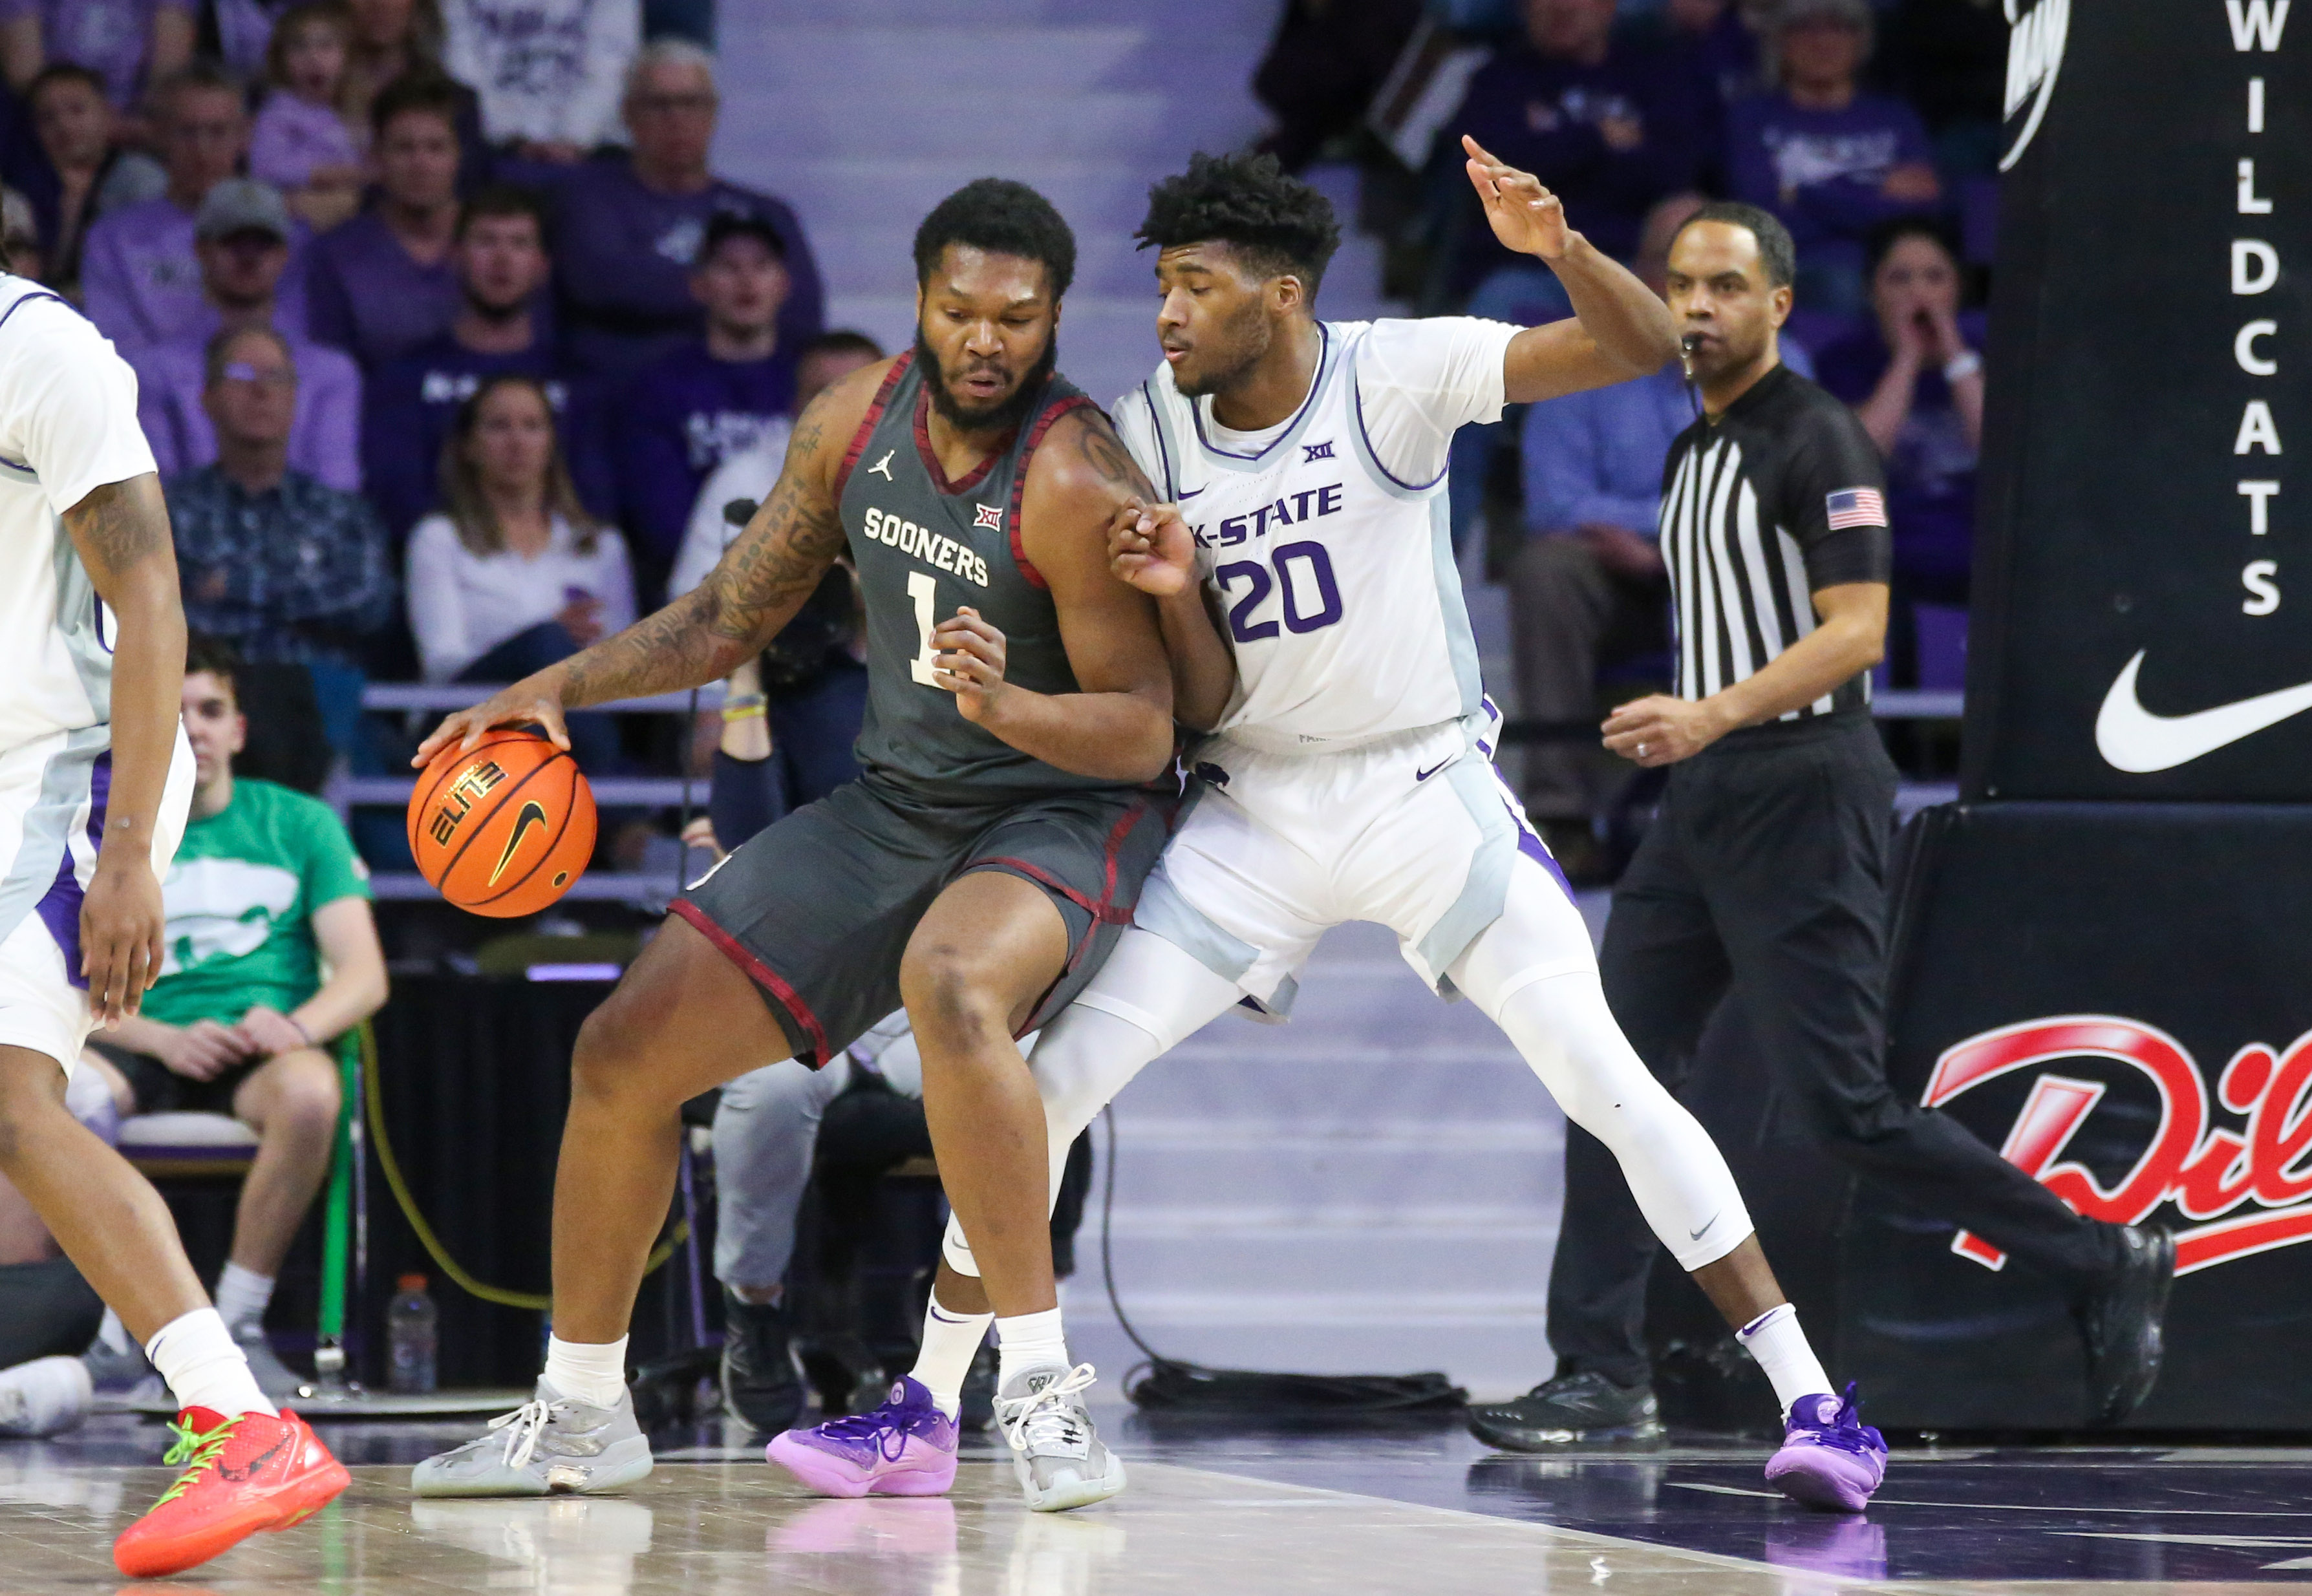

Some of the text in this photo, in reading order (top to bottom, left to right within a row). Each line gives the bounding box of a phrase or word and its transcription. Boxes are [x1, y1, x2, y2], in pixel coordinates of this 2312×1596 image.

[2224, 0, 2291, 615] WILDCATS
[1302, 440, 1335, 463] XII
[864, 507, 988, 588] SOONERS
[975, 505, 1002, 530] XII
[1188, 482, 1342, 549] K-STATE
[907, 570, 951, 689] 1
[1215, 540, 1342, 643] 20
[430, 761, 508, 847] ELITE
